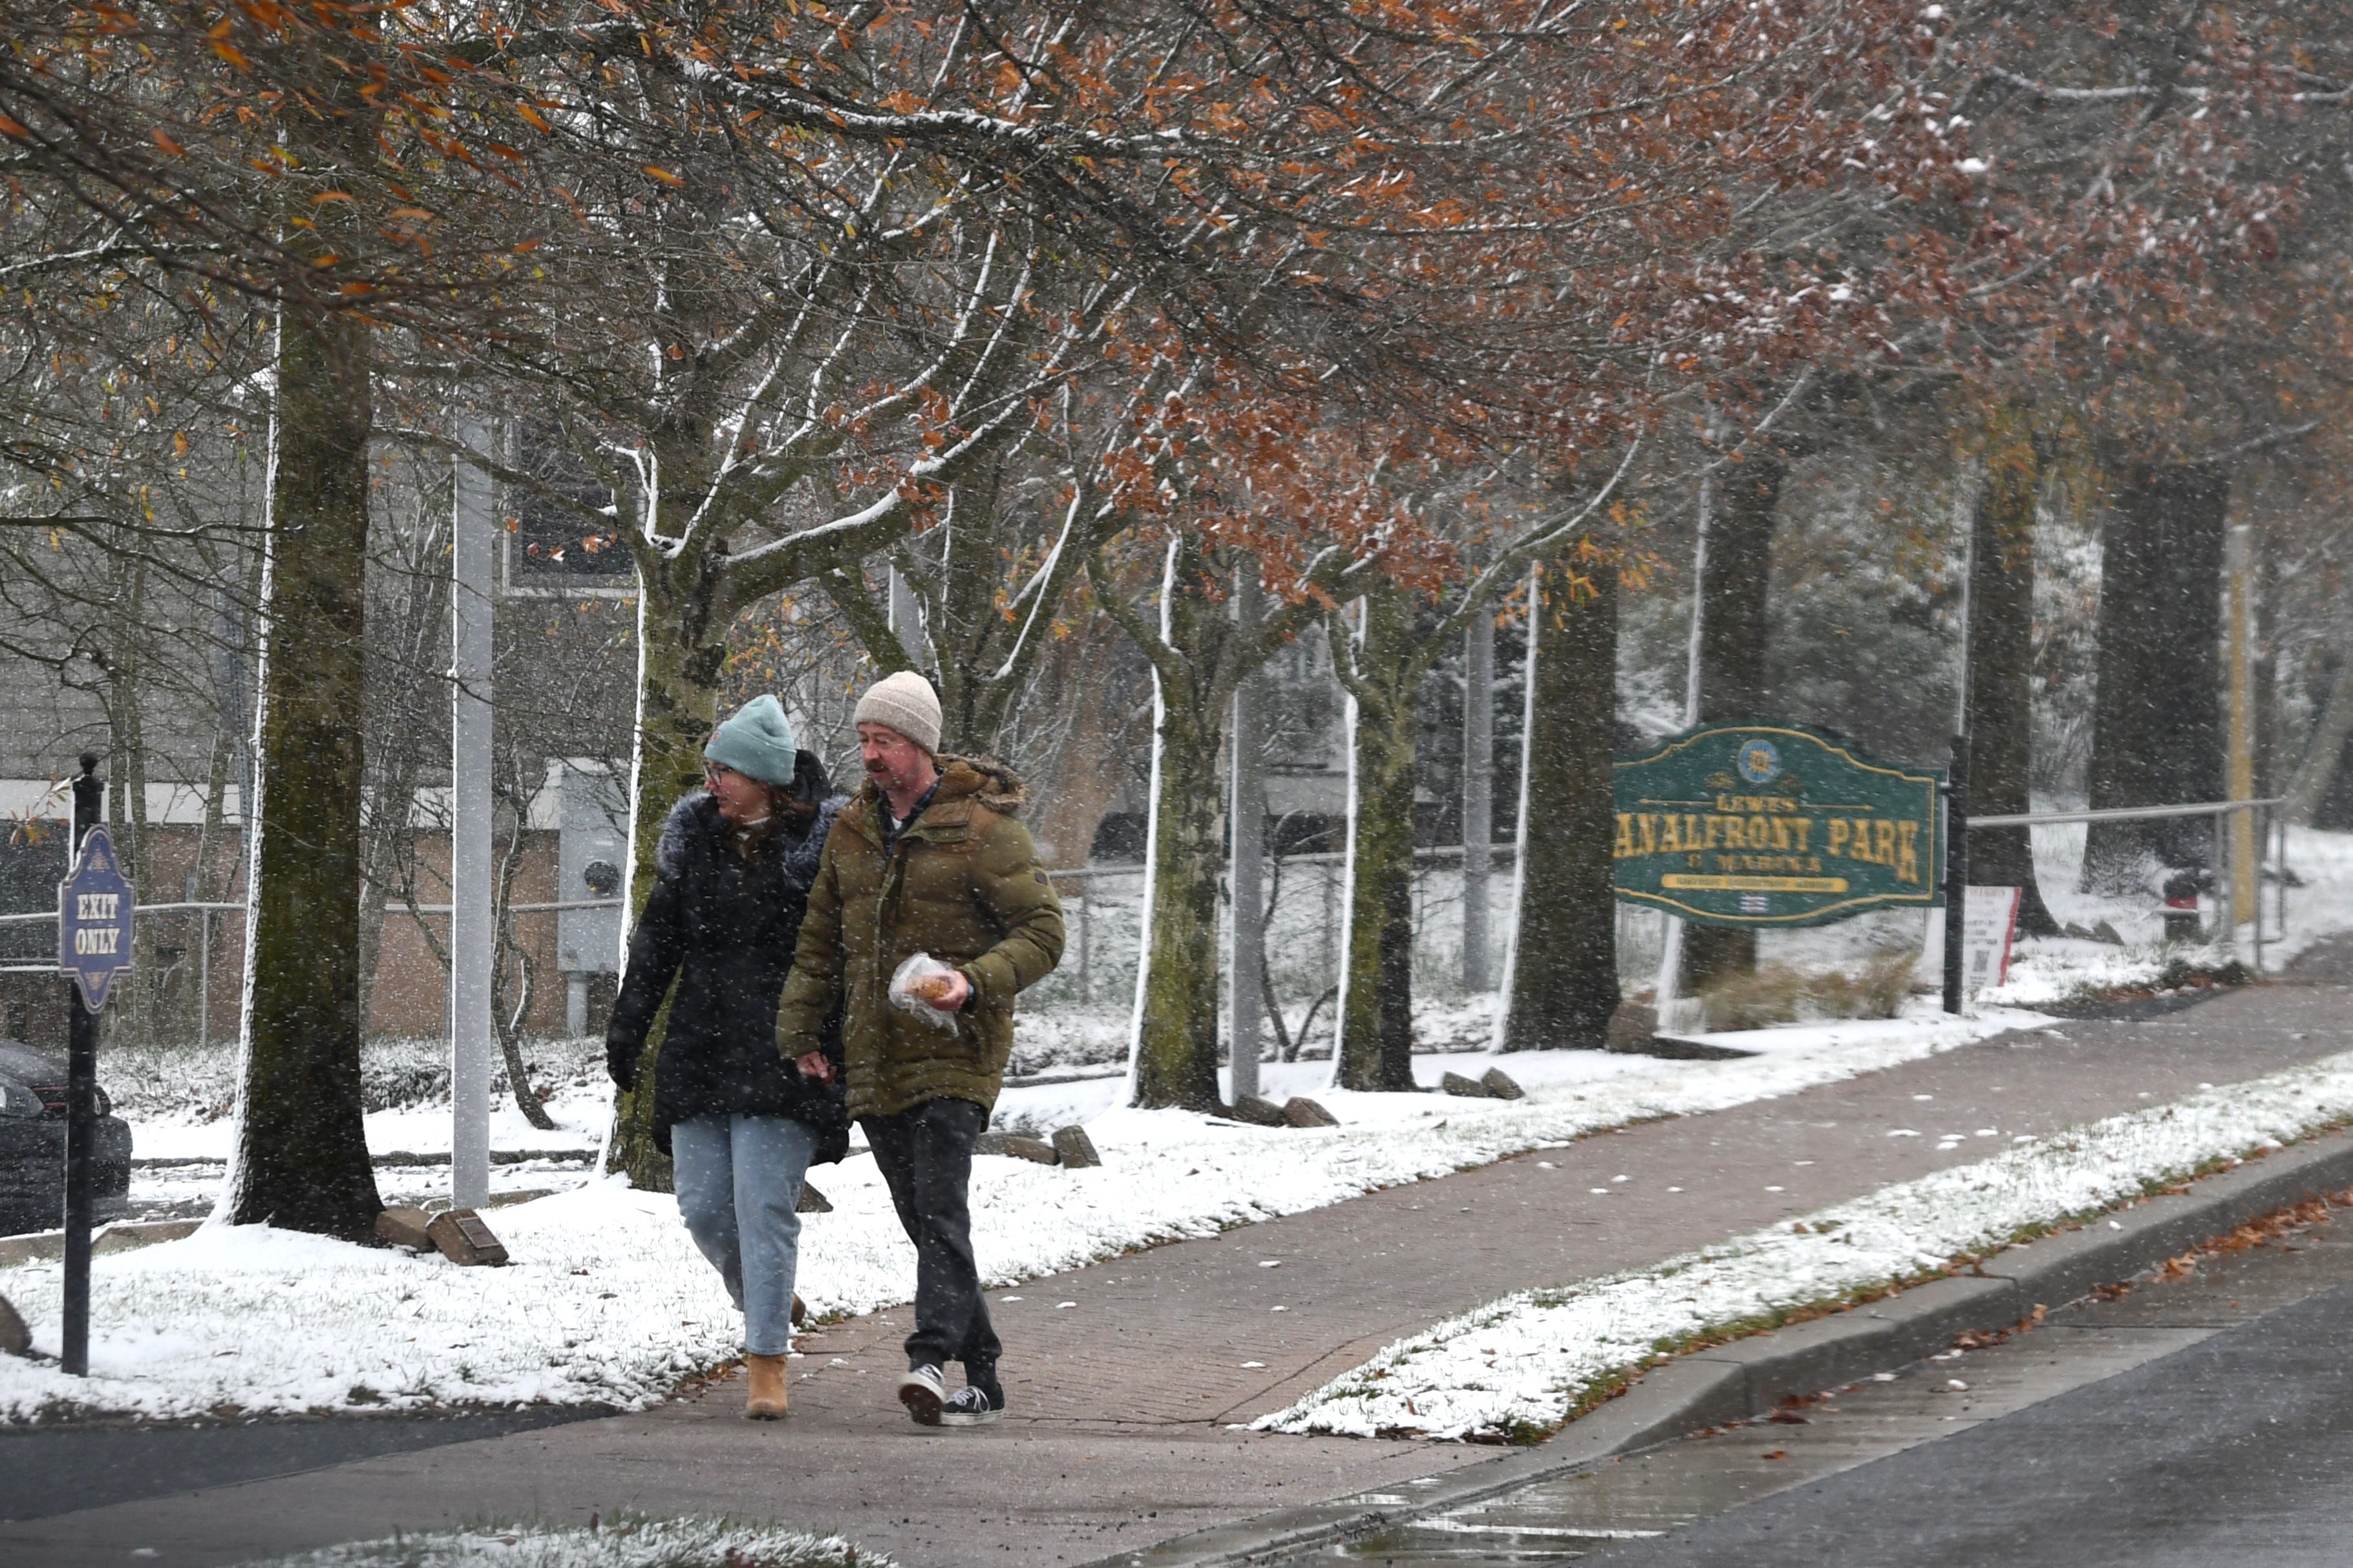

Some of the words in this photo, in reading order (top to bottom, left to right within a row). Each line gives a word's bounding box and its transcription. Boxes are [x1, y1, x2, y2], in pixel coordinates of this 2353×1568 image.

[1716, 796, 1797, 812] LEWES
[1613, 812, 1813, 858] ANALFRONT
[1827, 818, 1920, 884] PARK
[77, 893, 119, 920] EXIT
[75, 927, 120, 955] ONLY
